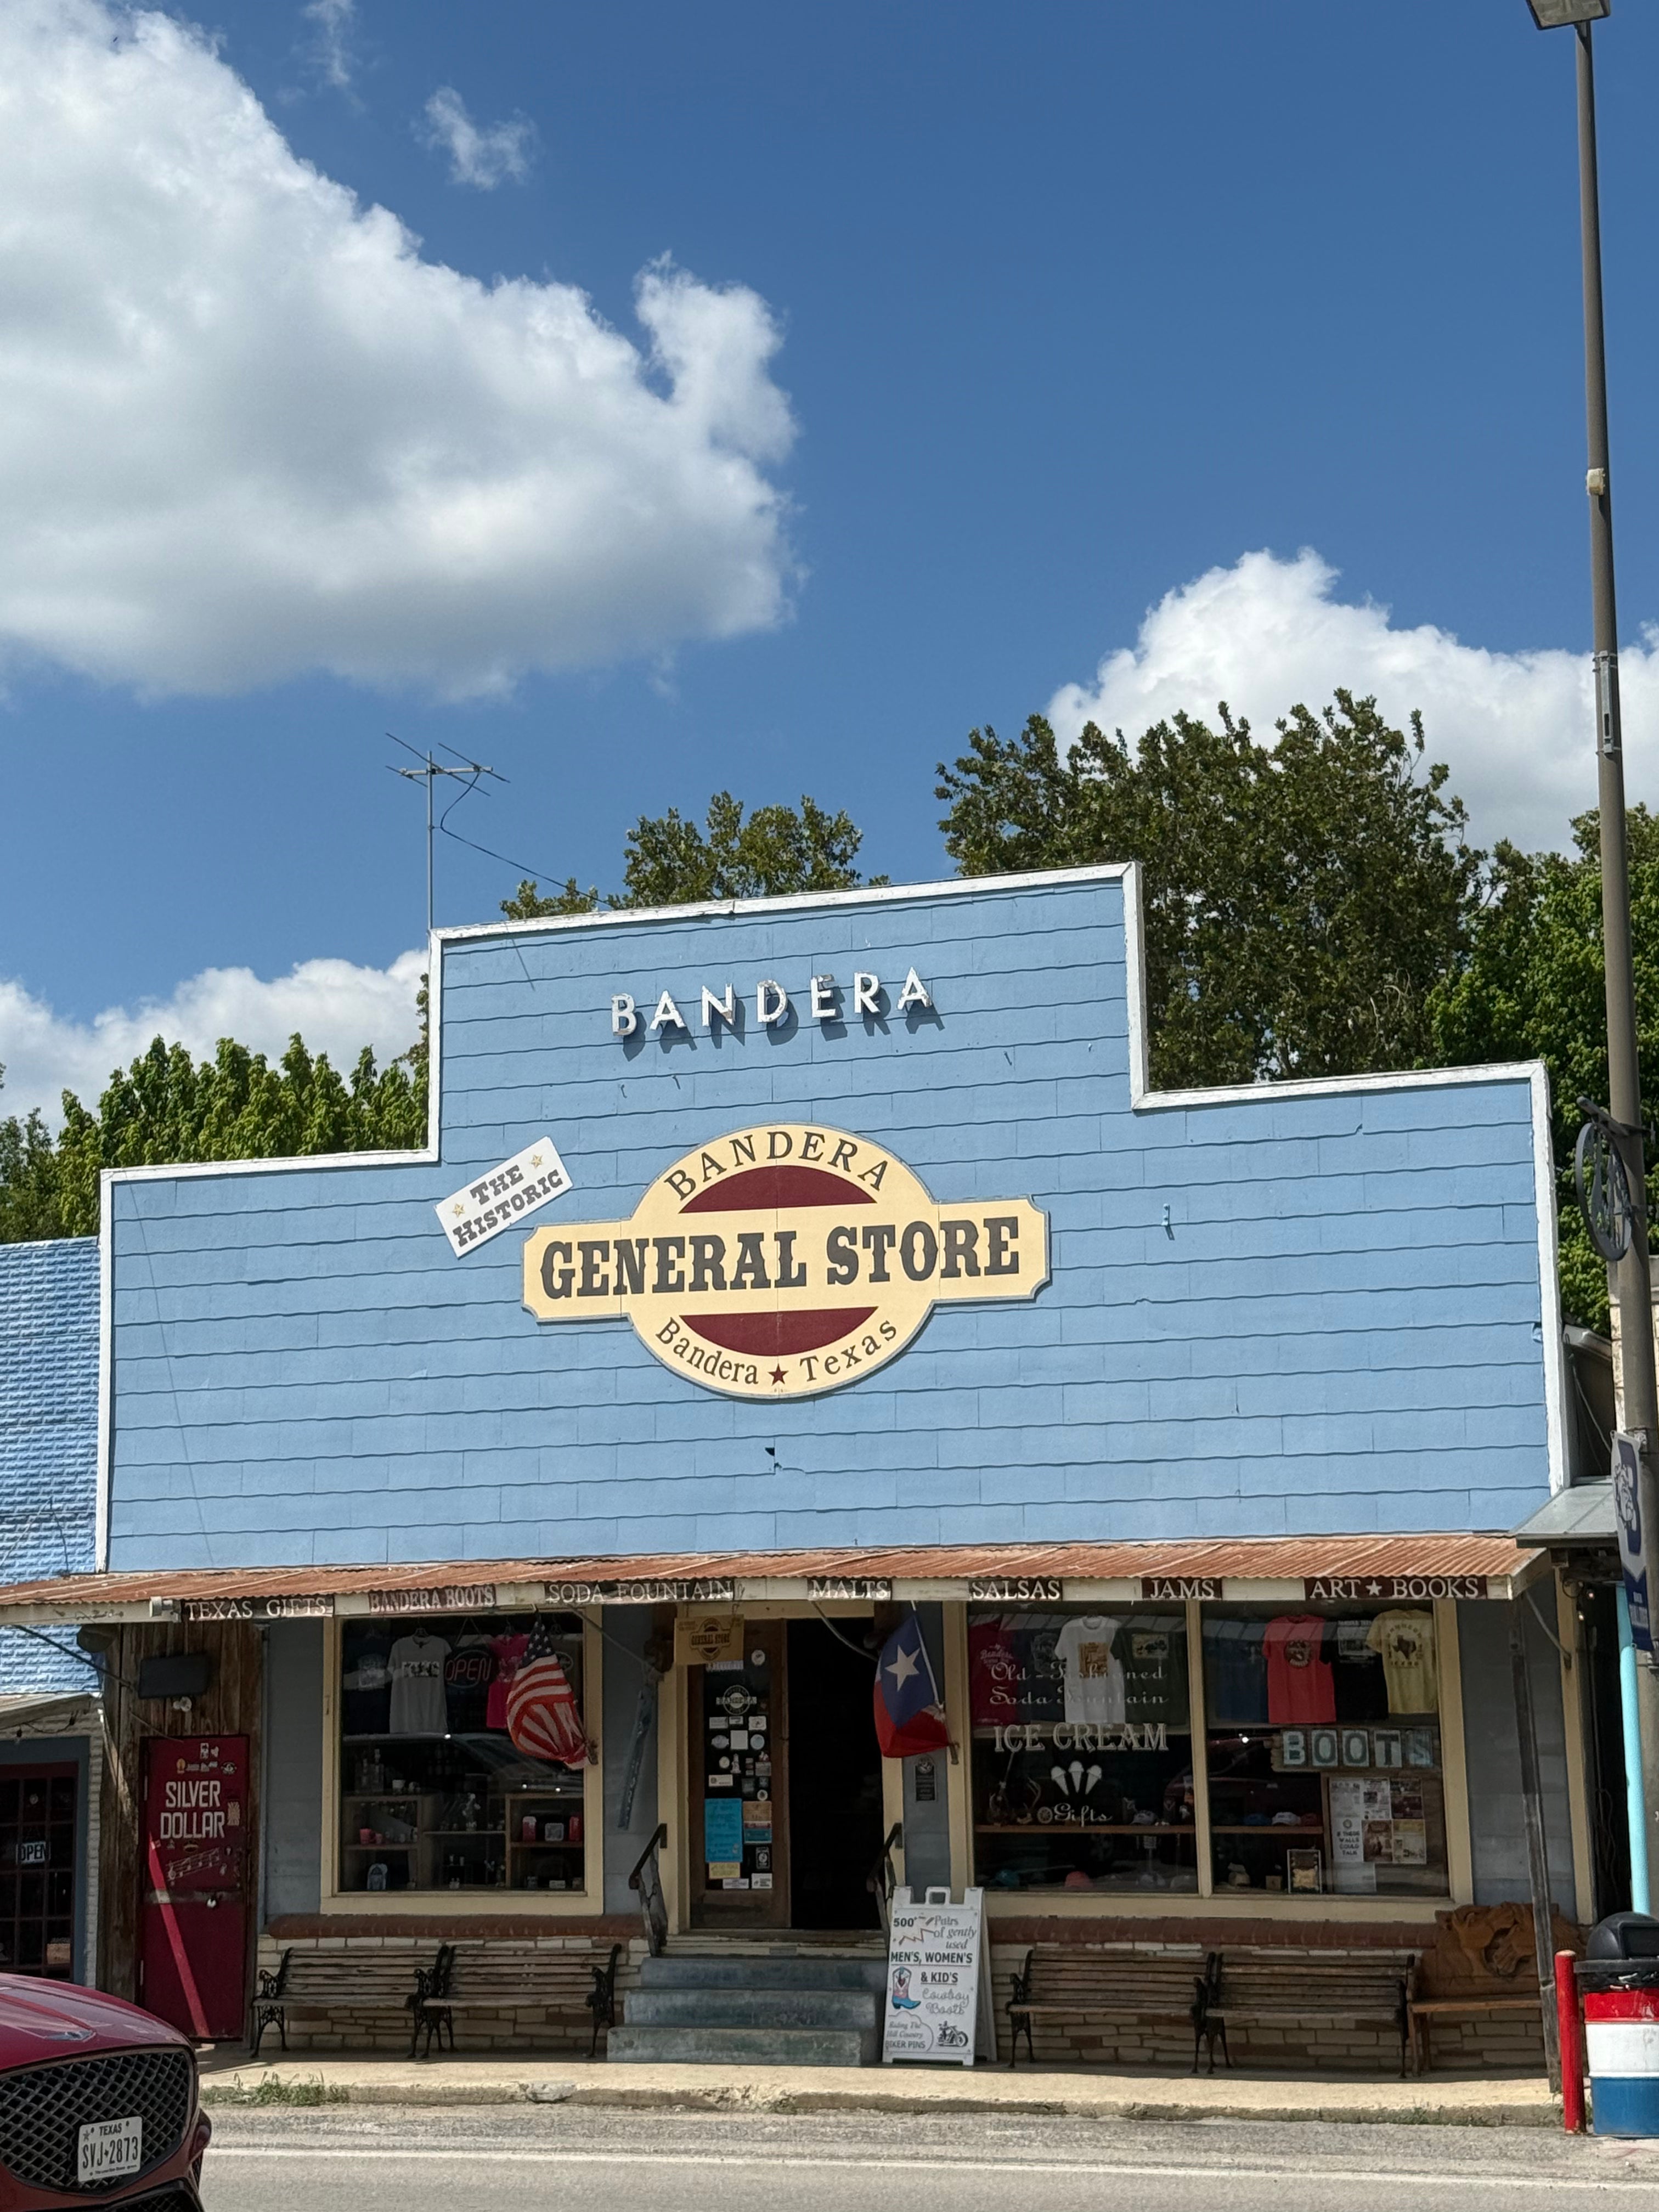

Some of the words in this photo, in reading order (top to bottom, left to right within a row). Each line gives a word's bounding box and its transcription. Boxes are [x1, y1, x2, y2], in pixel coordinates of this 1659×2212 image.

[611, 967, 933, 1036] BANDERA
[664, 1131, 888, 1201] BANDERA
[470, 1165, 524, 1205] THE
[453, 1169, 563, 1247] HISTORIC
[540, 1231, 807, 1299] GENERAL
[827, 1216, 1019, 1285] STORE
[655, 1317, 759, 1385] Bandera
[800, 1320, 898, 1383] Texas
[371, 1591, 442, 1612] BANDERA
[445, 1585, 494, 1607] BOOTS
[546, 1583, 603, 1603] SODA
[617, 1581, 733, 1601] FOUNTAIN
[812, 1579, 888, 1599] MALTS
[972, 1580, 1060, 1600] SALSAS
[1150, 1579, 1215, 1599] JAMS
[1310, 1579, 1360, 1599] ART
[1391, 1578, 1479, 1599] BOOKS
[185, 1601, 253, 1621] TEXAS
[266, 1598, 326, 1617] GIFTS
[445, 1658, 492, 1681] OPEN
[991, 1662, 1031, 1680] Old
[990, 1686, 1052, 1705] Soda
[994, 1725, 1045, 1752] ICE
[1053, 1723, 1169, 1752] CREAM
[1283, 1730, 1433, 1768] BOOTS
[166, 1780, 220, 1808] SILVER
[160, 1812, 225, 1839] DOLLAR
[1053, 1803, 1114, 1827] Gifts
[18, 1843, 49, 1861] OPEN
[935, 1915, 959, 1926] Pairs
[933, 1927, 944, 1938] of
[947, 1926, 977, 1939] gently
[945, 1939, 968, 1949] used
[890, 1951, 922, 1964] MEN'S,
[925, 1951, 973, 1964] WOMEN'S
[921, 1972, 927, 1983] &
[930, 1972, 958, 1983] KID'S
[922, 1988, 969, 2008] Cowboy
[926, 2002, 965, 2015] Boots
[908, 2041, 926, 2049] PINS
[99, 2123, 122, 2136] TEXAS
